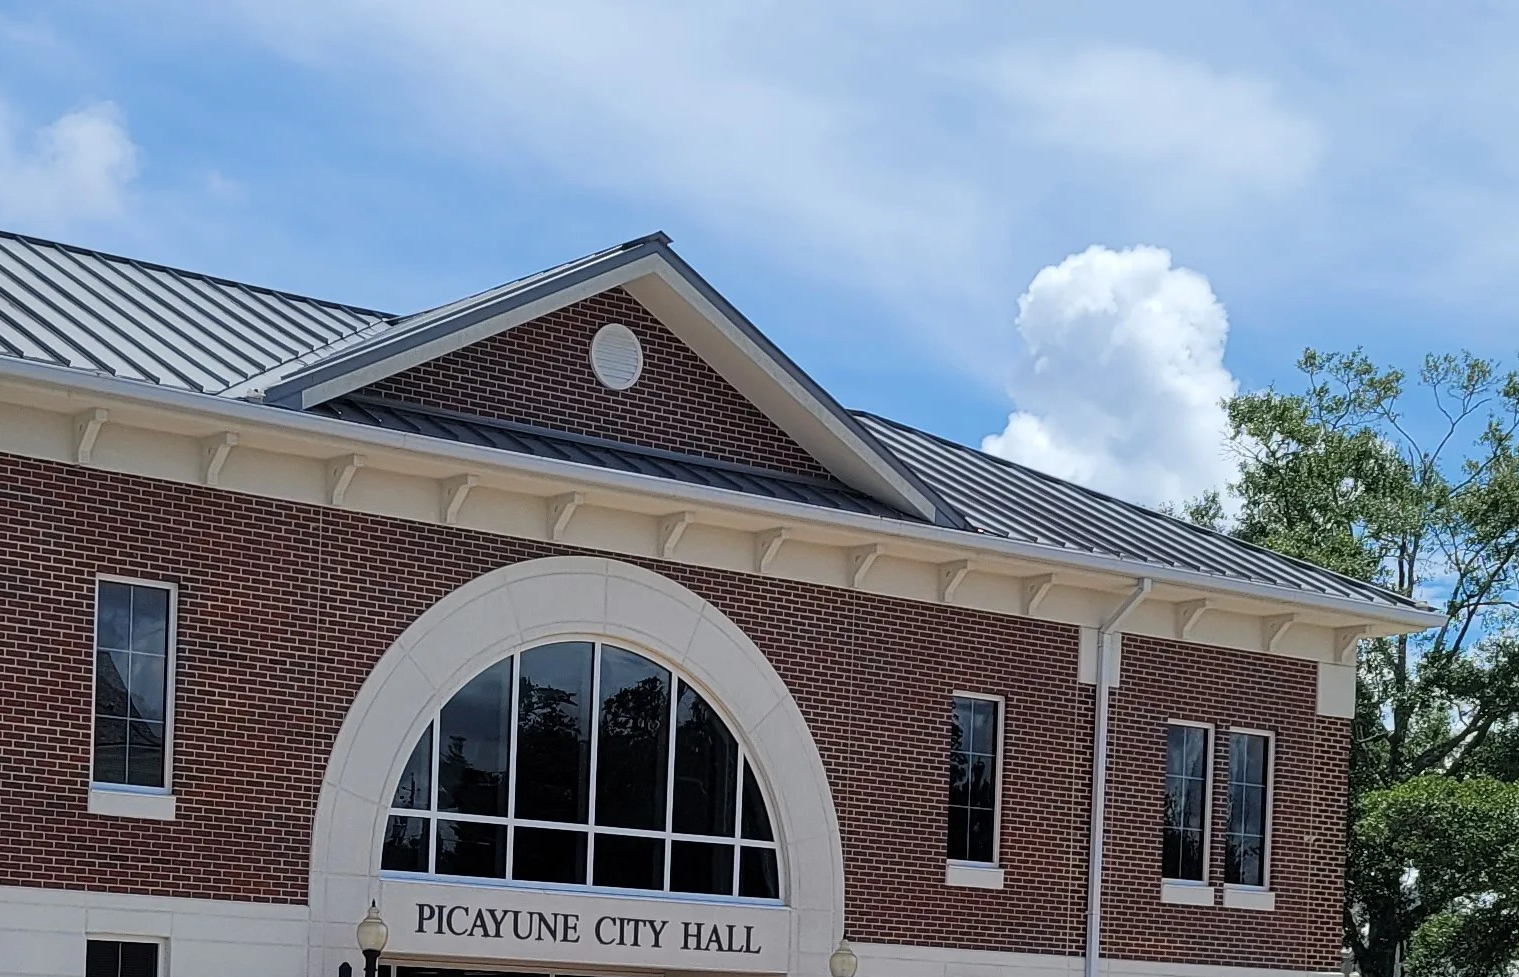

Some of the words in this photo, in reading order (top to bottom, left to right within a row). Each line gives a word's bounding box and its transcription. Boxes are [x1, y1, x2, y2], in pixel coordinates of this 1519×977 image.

[414, 903, 581, 944] PICAYUNE
[594, 915, 669, 949] CITY
[681, 922, 762, 954] HALL
